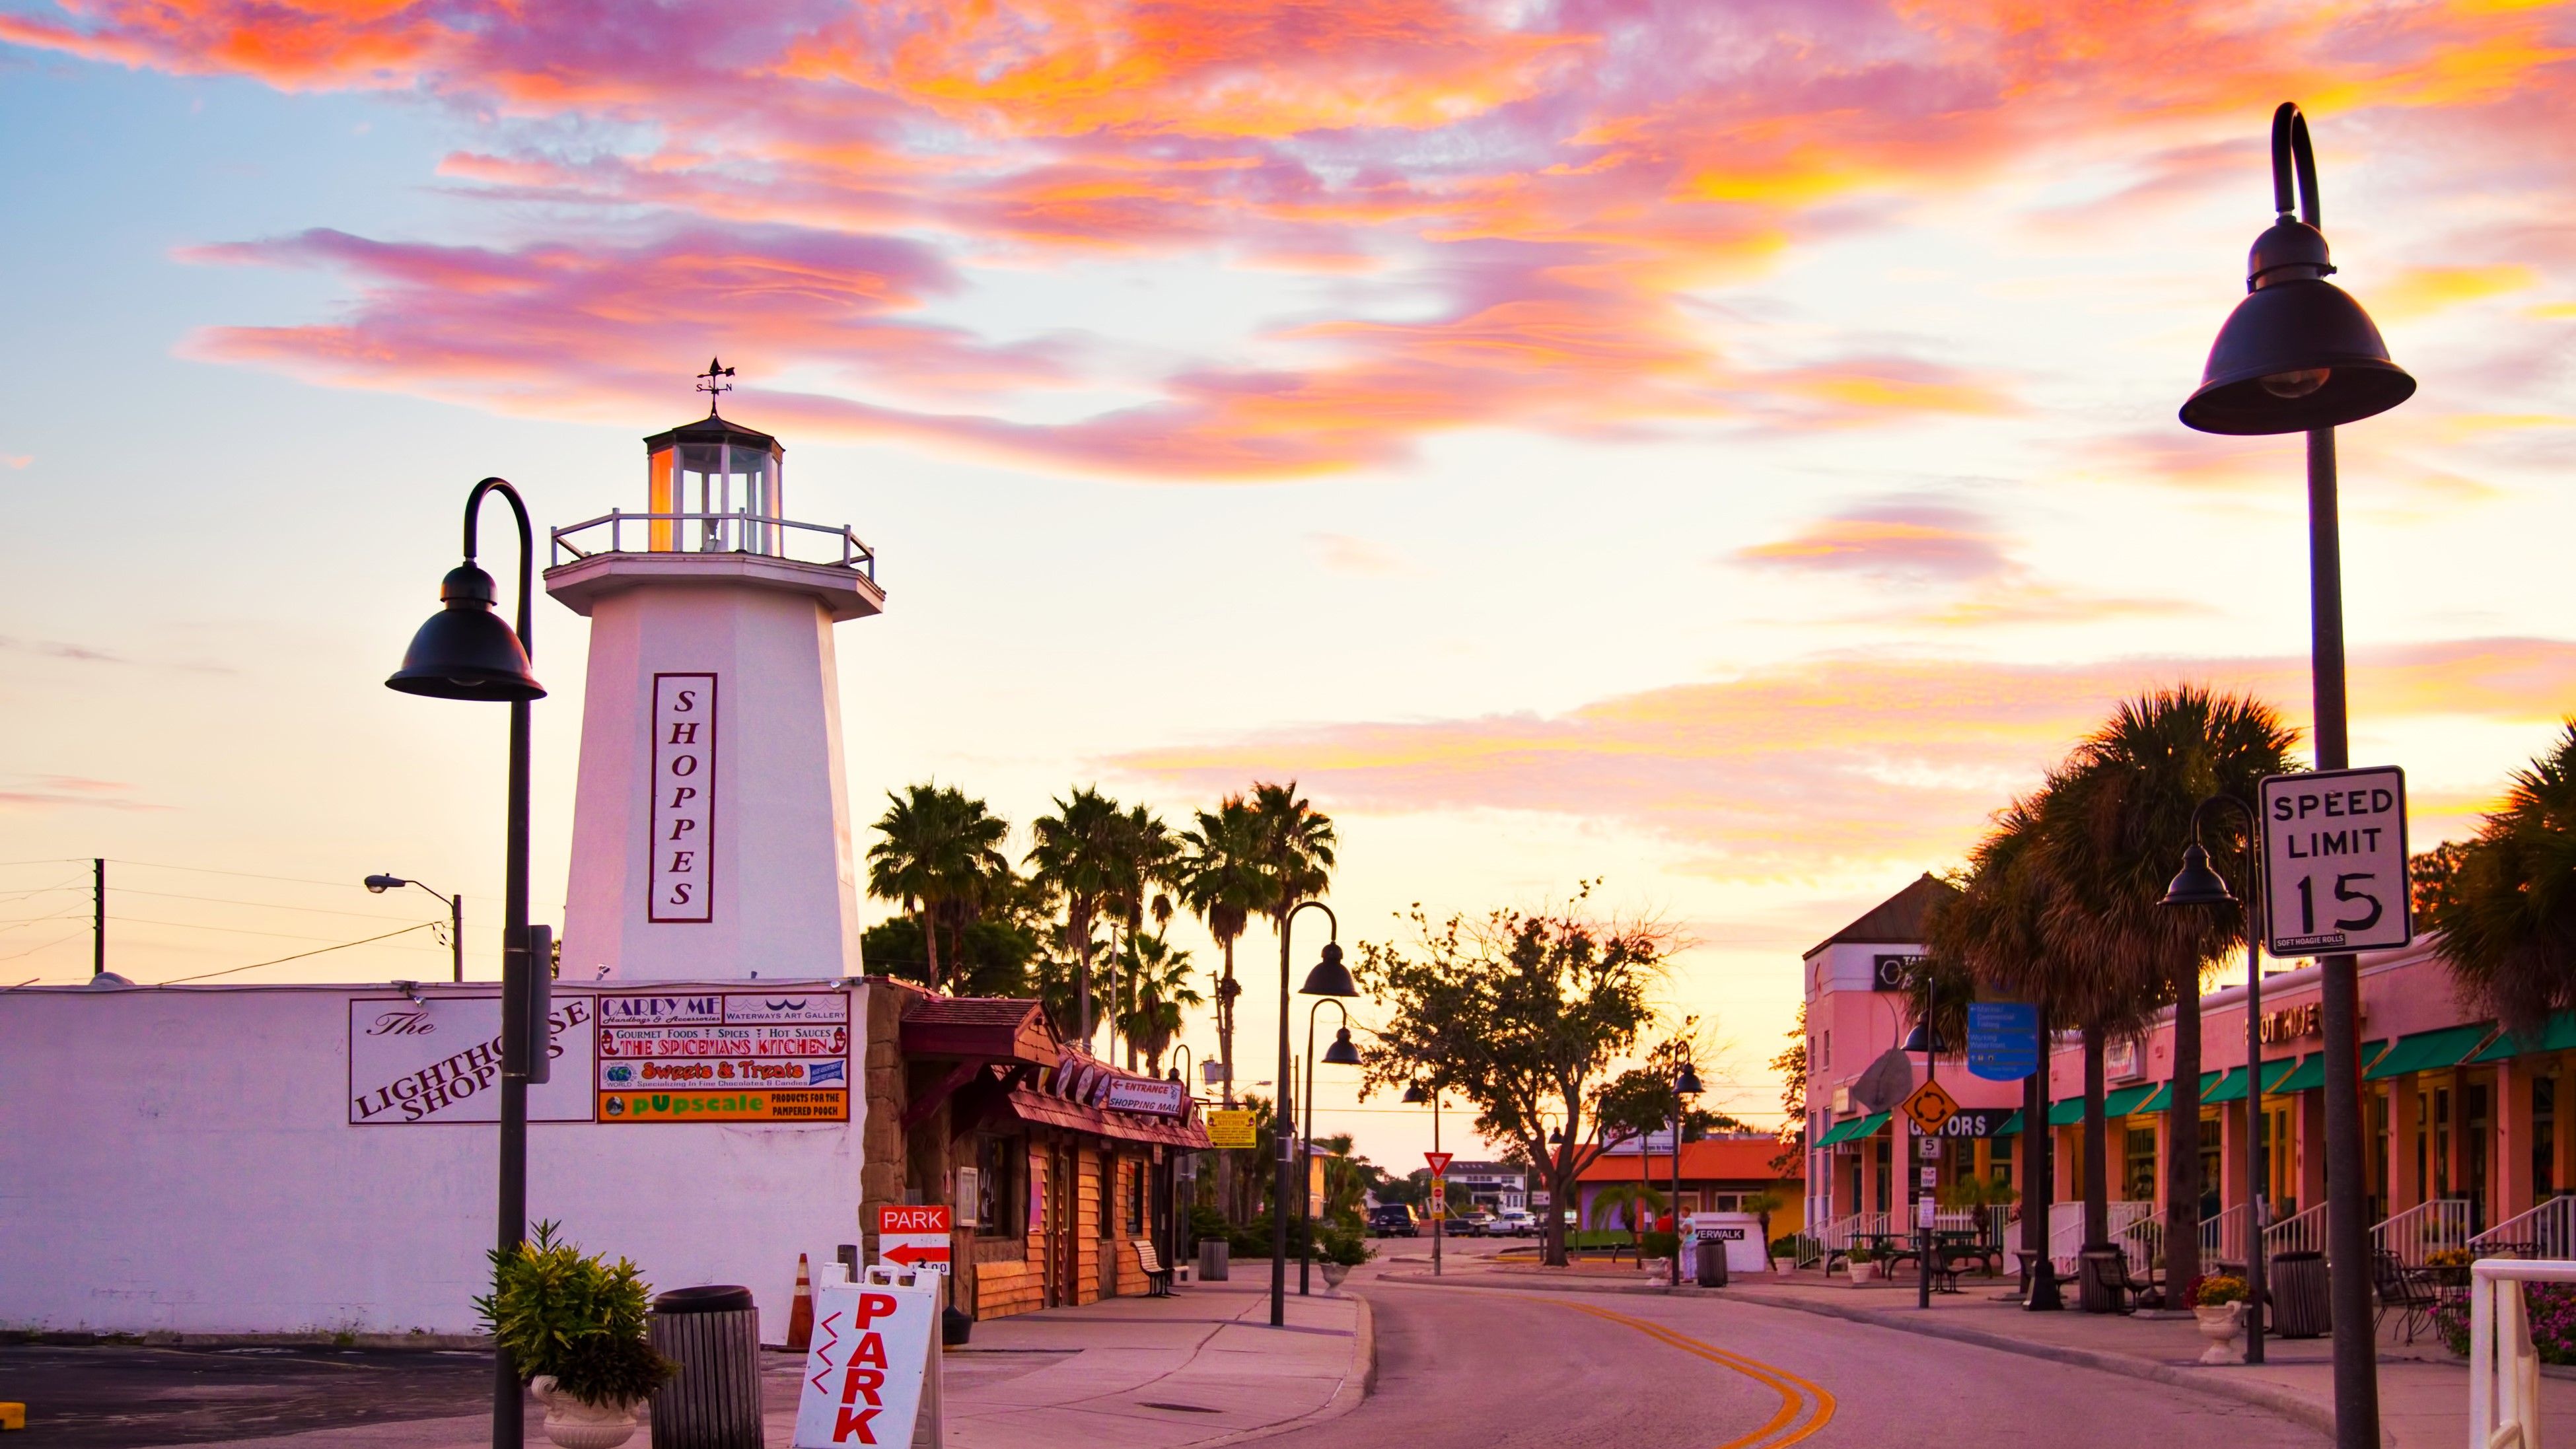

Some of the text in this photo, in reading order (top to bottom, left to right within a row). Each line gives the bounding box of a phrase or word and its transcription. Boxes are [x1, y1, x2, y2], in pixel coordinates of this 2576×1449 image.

[668, 690, 700, 905] SHOPPES
[2273, 789, 2393, 821] SPEED
[2288, 828, 2382, 858] LIMIT
[2297, 873, 2382, 934] 15
[602, 997, 720, 1016] CARRY ME
[366, 1012, 437, 1036] The
[616, 1028, 830, 1039] GOURMET FOODS SPICES HOT SAUCES
[620, 1038, 826, 1055] THE SPICEMANS KITCHEN
[355, 1001, 590, 1119] LIGHTHSE
[400, 1037, 564, 1121] SHOPS
[641, 1062, 713, 1080] Sweets
[717, 1061, 735, 1078] &
[738, 1060, 805, 1080] Treats
[771, 1093, 840, 1102] PRODUCTS FOR THE
[1125, 1082, 1168, 1094] ENTRANCE
[772, 1106, 838, 1115] PAMPERED POOCH
[1110, 1098, 1155, 1110] SHOPPING
[1925, 1139, 1935, 1151] 5
[884, 1211, 943, 1228] PARK
[832, 1293, 898, 1445] PARK
